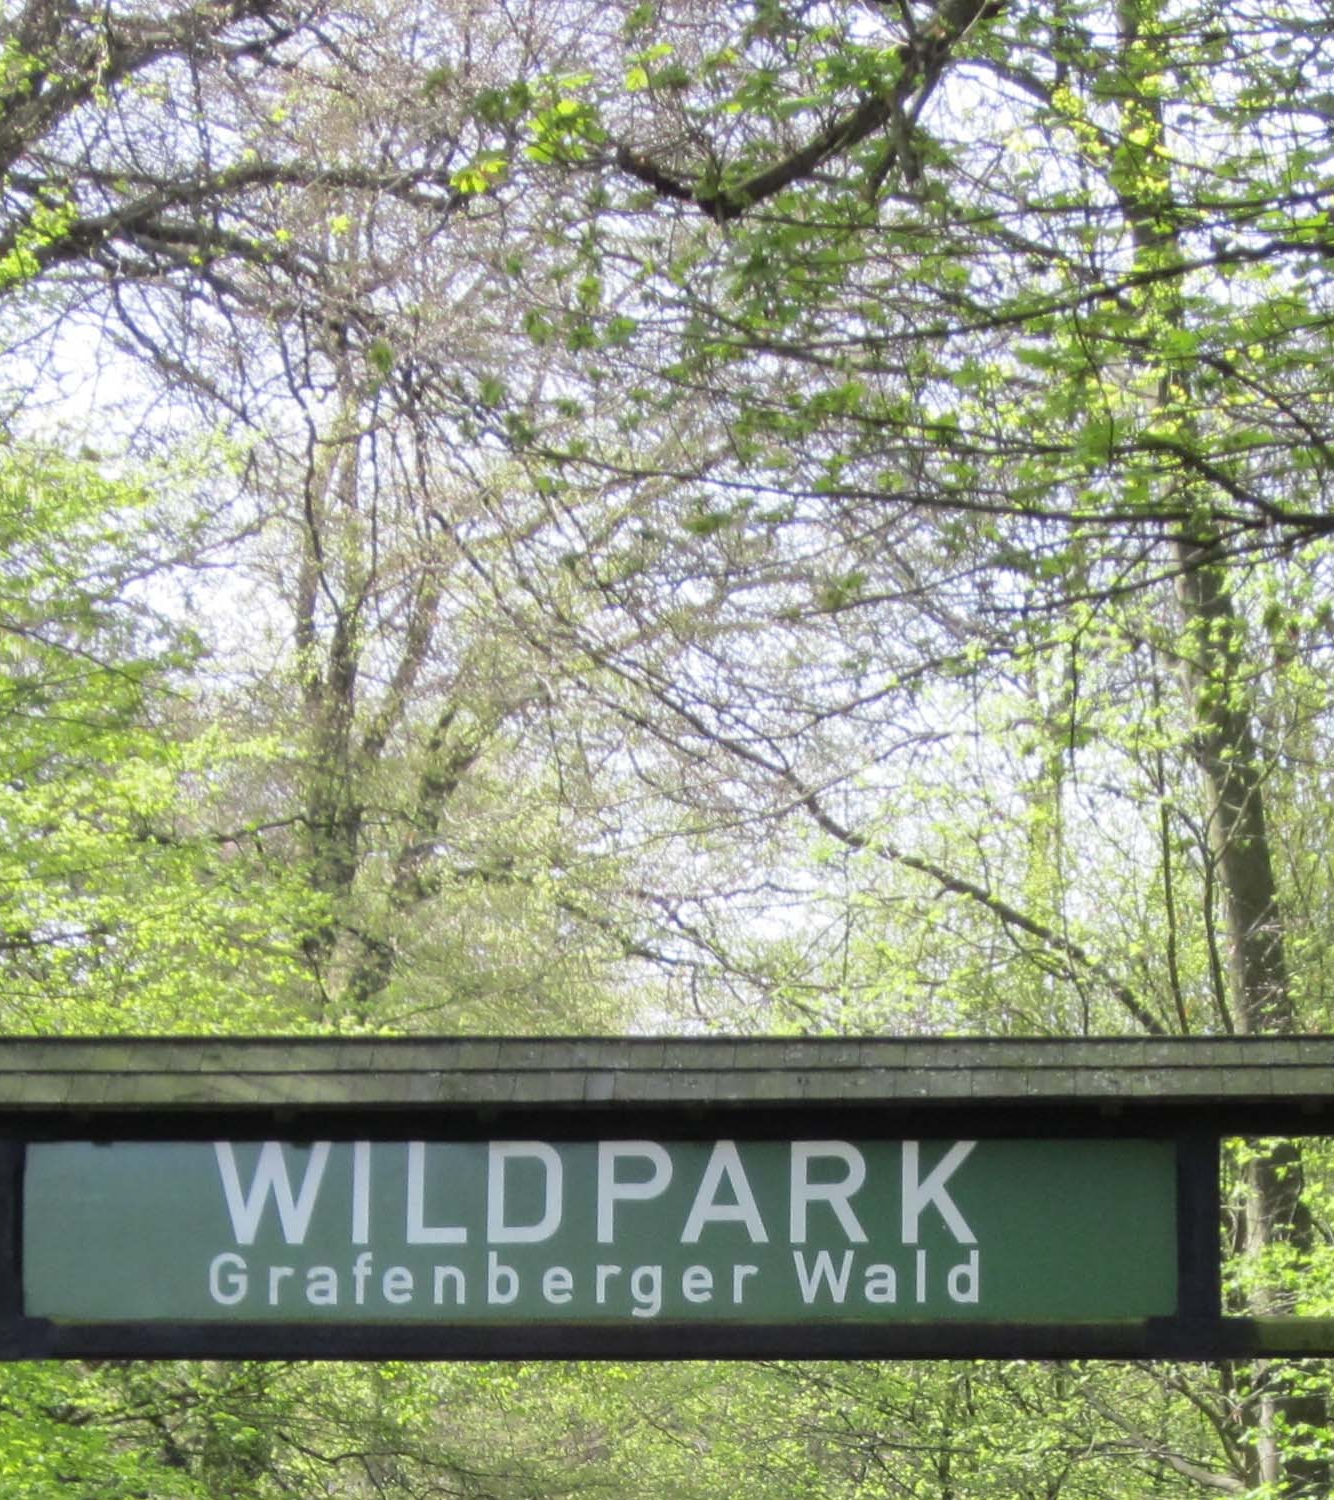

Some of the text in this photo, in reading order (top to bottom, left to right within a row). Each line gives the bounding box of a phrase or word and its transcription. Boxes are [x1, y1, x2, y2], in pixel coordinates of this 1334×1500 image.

[215, 1142, 976, 1244] WILDPARK
[210, 1250, 979, 1317] Grafenberger Wald
